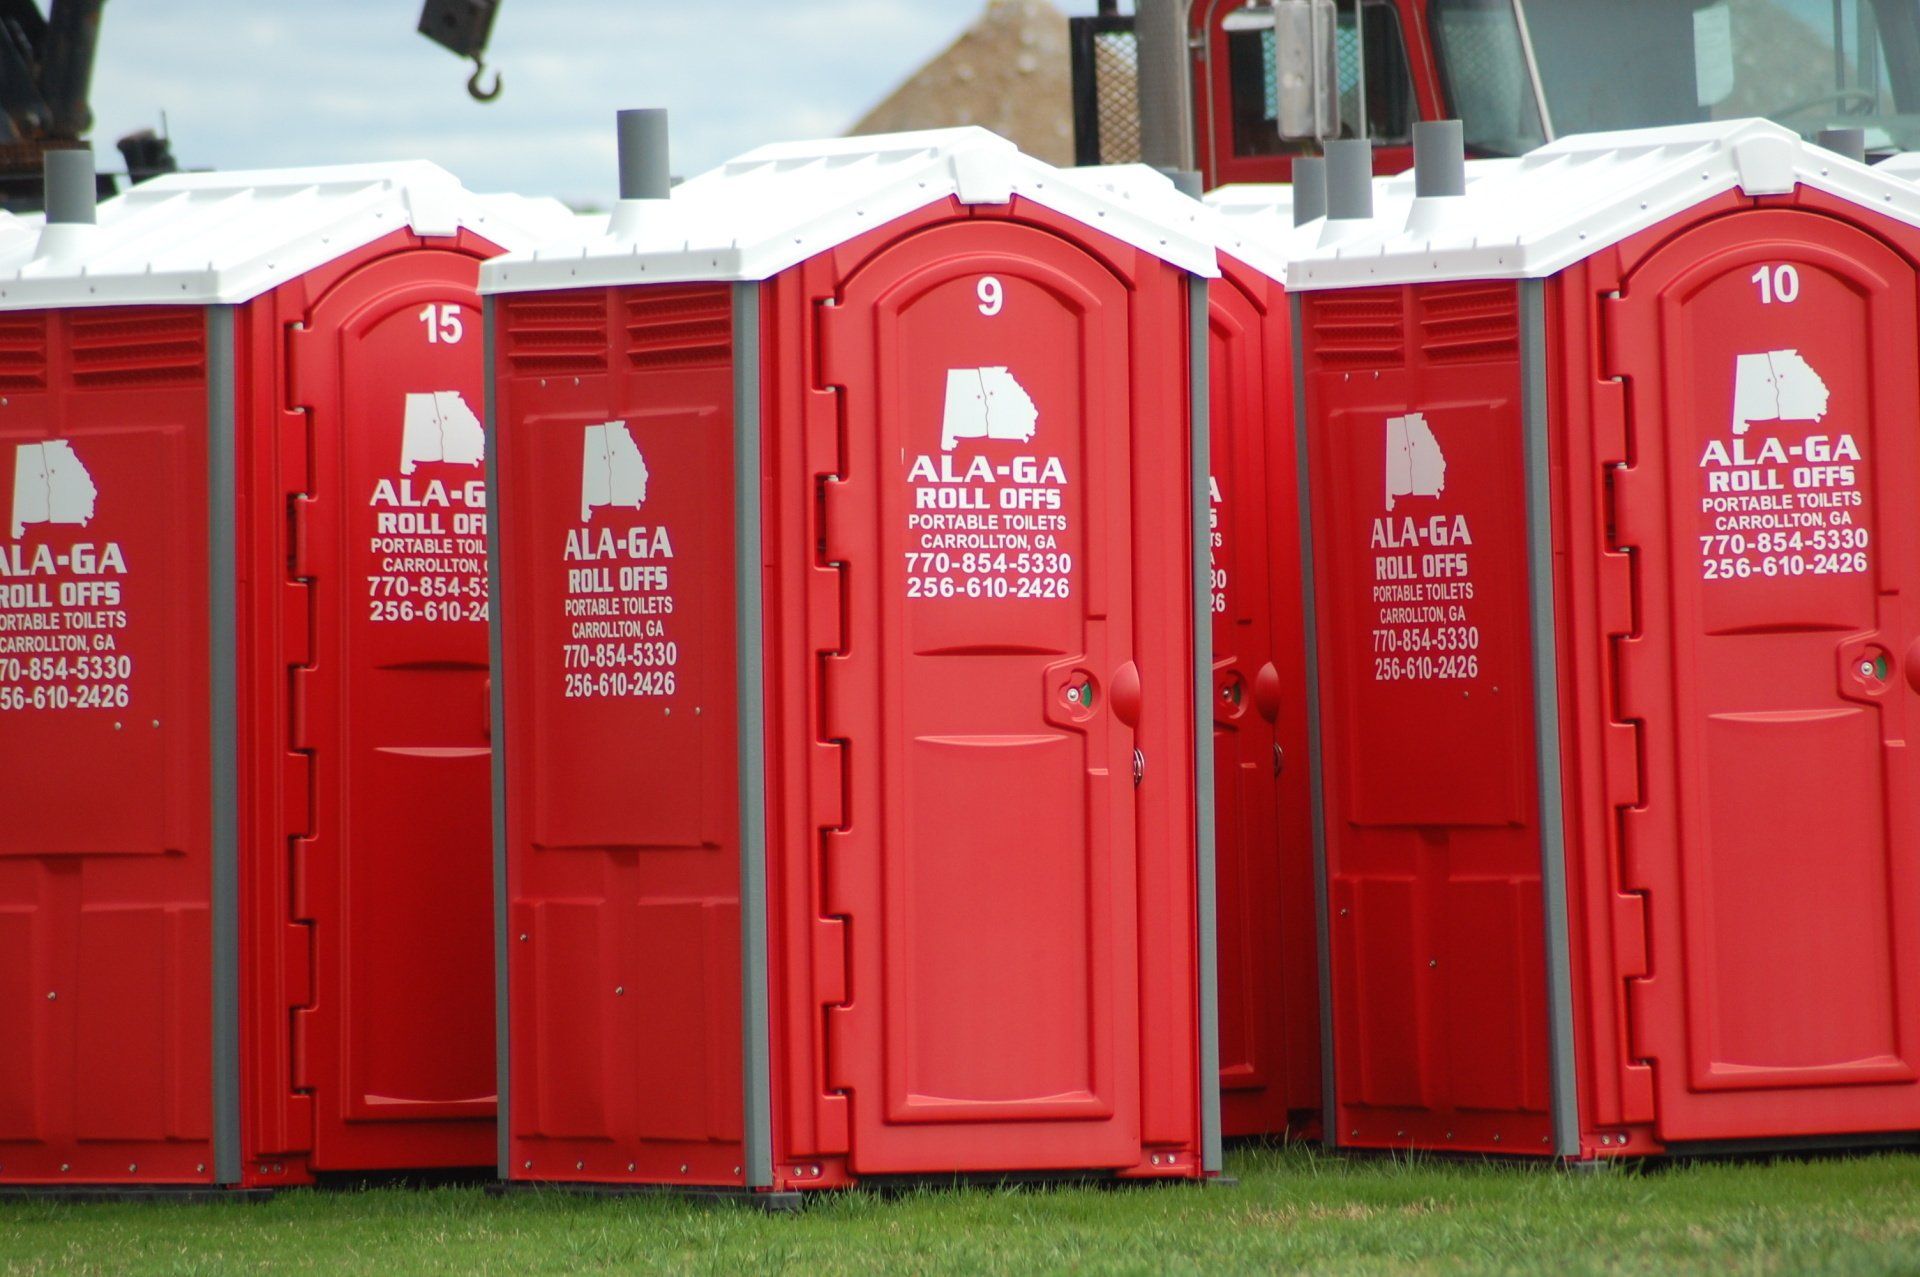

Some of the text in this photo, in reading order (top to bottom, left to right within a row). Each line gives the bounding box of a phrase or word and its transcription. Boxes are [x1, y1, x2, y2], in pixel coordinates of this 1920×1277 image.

[976, 276, 1003, 316] 9
[1752, 264, 1799, 304] 10
[419, 304, 463, 344] 15
[1699, 434, 1861, 467] ALA-GA
[907, 455, 1068, 484] ALA-GA
[1708, 465, 1855, 493] ROLL OFFS
[369, 478, 487, 508] ALA-G
[916, 487, 1061, 510] ROLL OFFS
[1702, 491, 1862, 513] PORTABLE TOILETS
[377, 512, 446, 535] ROLL
[908, 514, 1067, 531] PORTABLE TOILETS
[1370, 514, 1473, 549] ALA-GA
[1715, 511, 1852, 531] CARROLLTON, GA
[370, 537, 488, 555] PORTABLE TOIL
[563, 526, 674, 561] ALA-GA
[920, 533, 1057, 551] CARROLLTON, GA
[1700, 528, 1868, 556] 770-854-5330
[382, 557, 482, 575] CARROLLTON,
[904, 552, 1072, 574] 770-854-5330
[1375, 553, 1468, 581] ROLL OFFS
[1703, 552, 1867, 580] 256-610-2426
[367, 575, 488, 598] 770-854-53
[568, 566, 668, 594] ROLL OFFS
[907, 577, 1070, 598] 256-610-2426
[1373, 582, 1474, 603] PORTABLE TOILETS
[59, 581, 121, 607] OFFS
[565, 595, 673, 617] PORTABLE TOILETS
[0, 610, 127, 632] ORTABLE TOILETS
[369, 600, 489, 622] 256-610-24
[1380, 605, 1466, 625] CARROLLTON, GA
[93, 633, 116, 651] GA
[571, 619, 665, 640] CARROLLTON, GA
[1372, 626, 1479, 653] 770-854-5330
[563, 641, 677, 668] 770-854-5330
[1374, 654, 1478, 681] 256-610-2426
[0, 655, 132, 682] 70-854-5330
[0, 683, 129, 711] 56-610-2426
[565, 671, 676, 698] 256-610-2426
